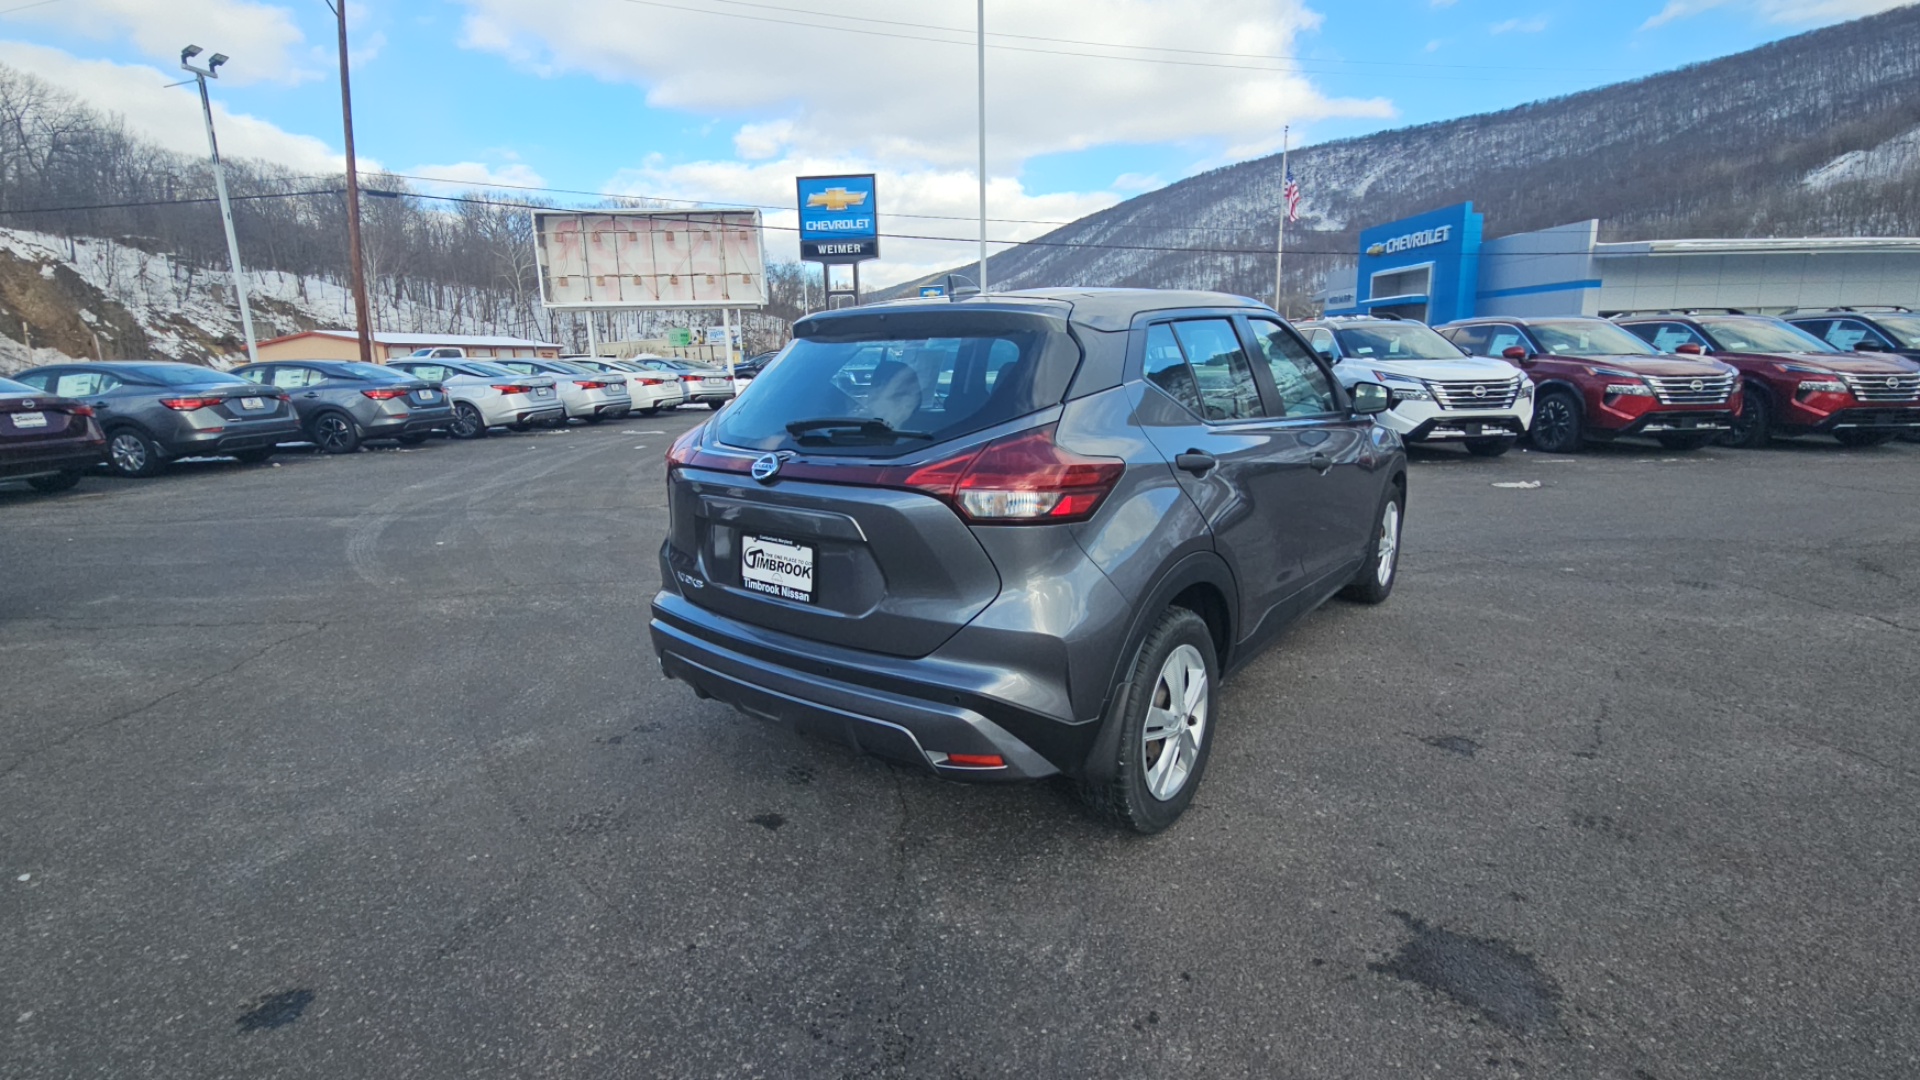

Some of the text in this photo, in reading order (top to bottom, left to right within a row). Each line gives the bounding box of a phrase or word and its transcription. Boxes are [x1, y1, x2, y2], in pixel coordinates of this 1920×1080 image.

[805, 219, 870, 231] CHEVROLET
[818, 244, 861, 254] WEIMER
[1386, 224, 1452, 253] CHEVROLET
[744, 547, 812, 579] TIMBROOK
[744, 577, 810, 602] Timbrook Nissan
